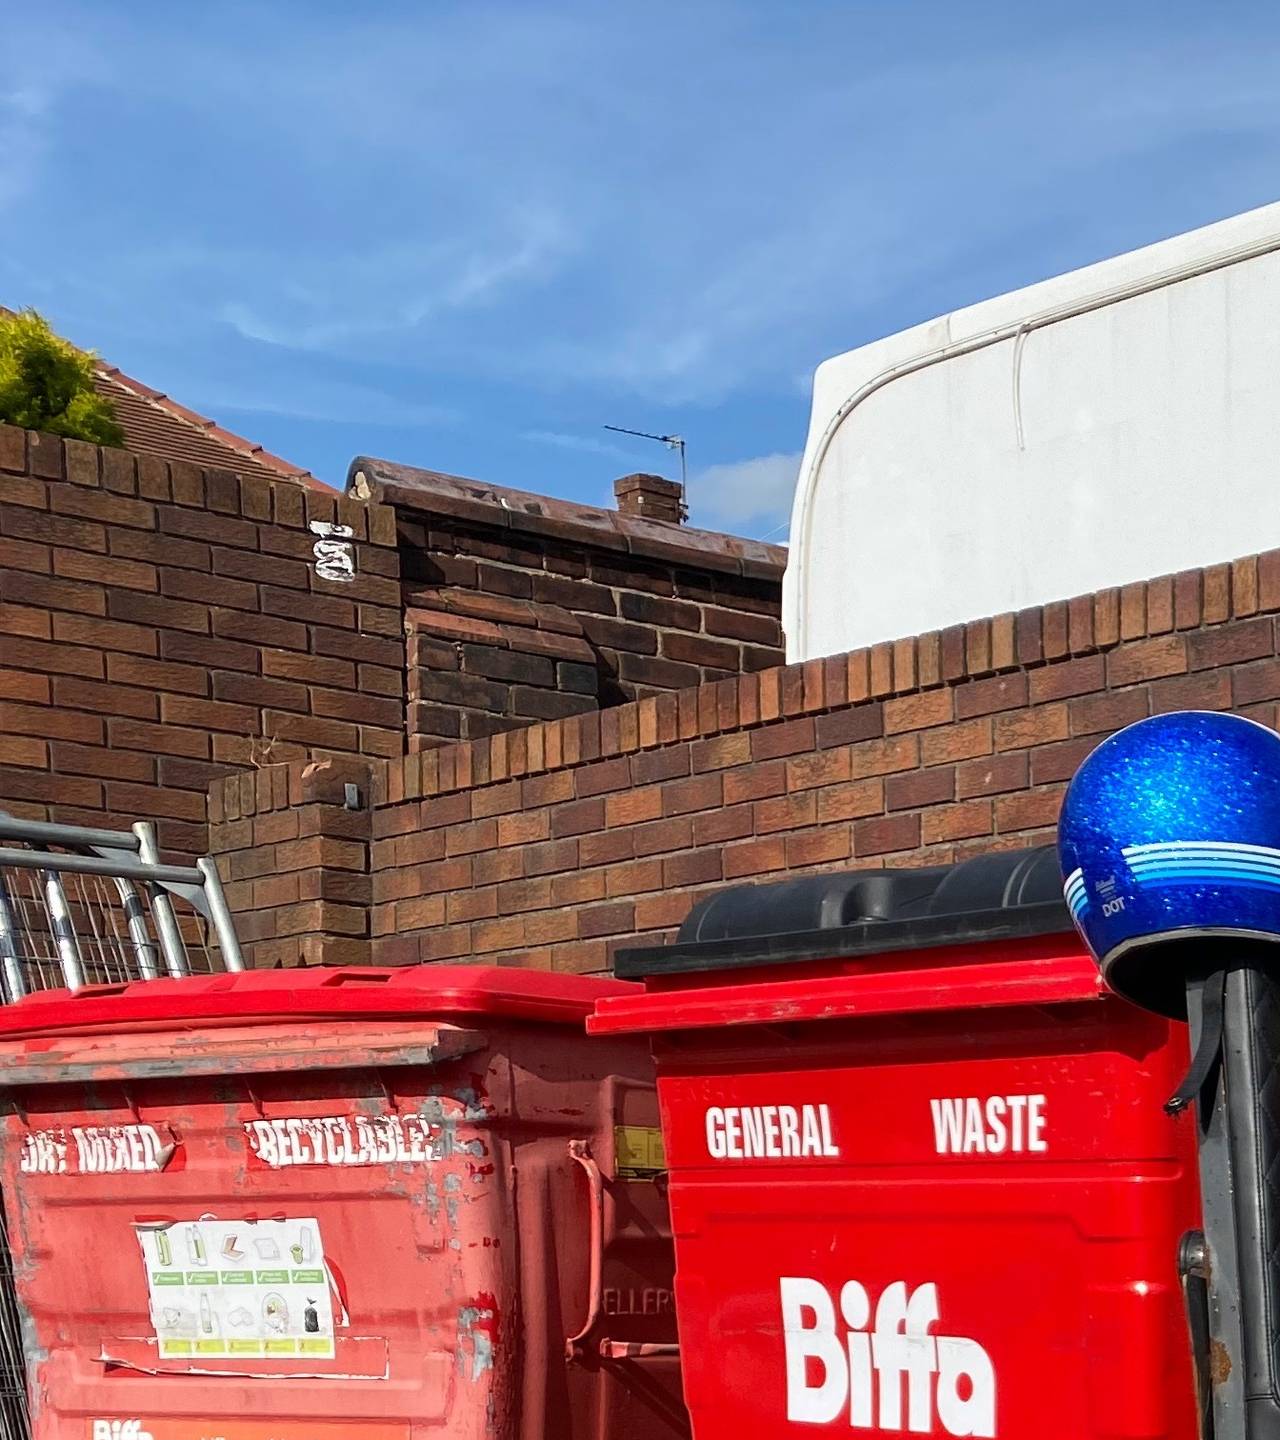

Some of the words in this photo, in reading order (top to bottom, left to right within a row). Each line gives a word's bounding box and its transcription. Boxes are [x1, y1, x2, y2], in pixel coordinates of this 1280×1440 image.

[1102, 896, 1126, 917] DOT
[705, 1103, 839, 1159] GENERAL
[930, 1094, 1048, 1154] WASTE
[779, 1276, 998, 1439] Biffa
